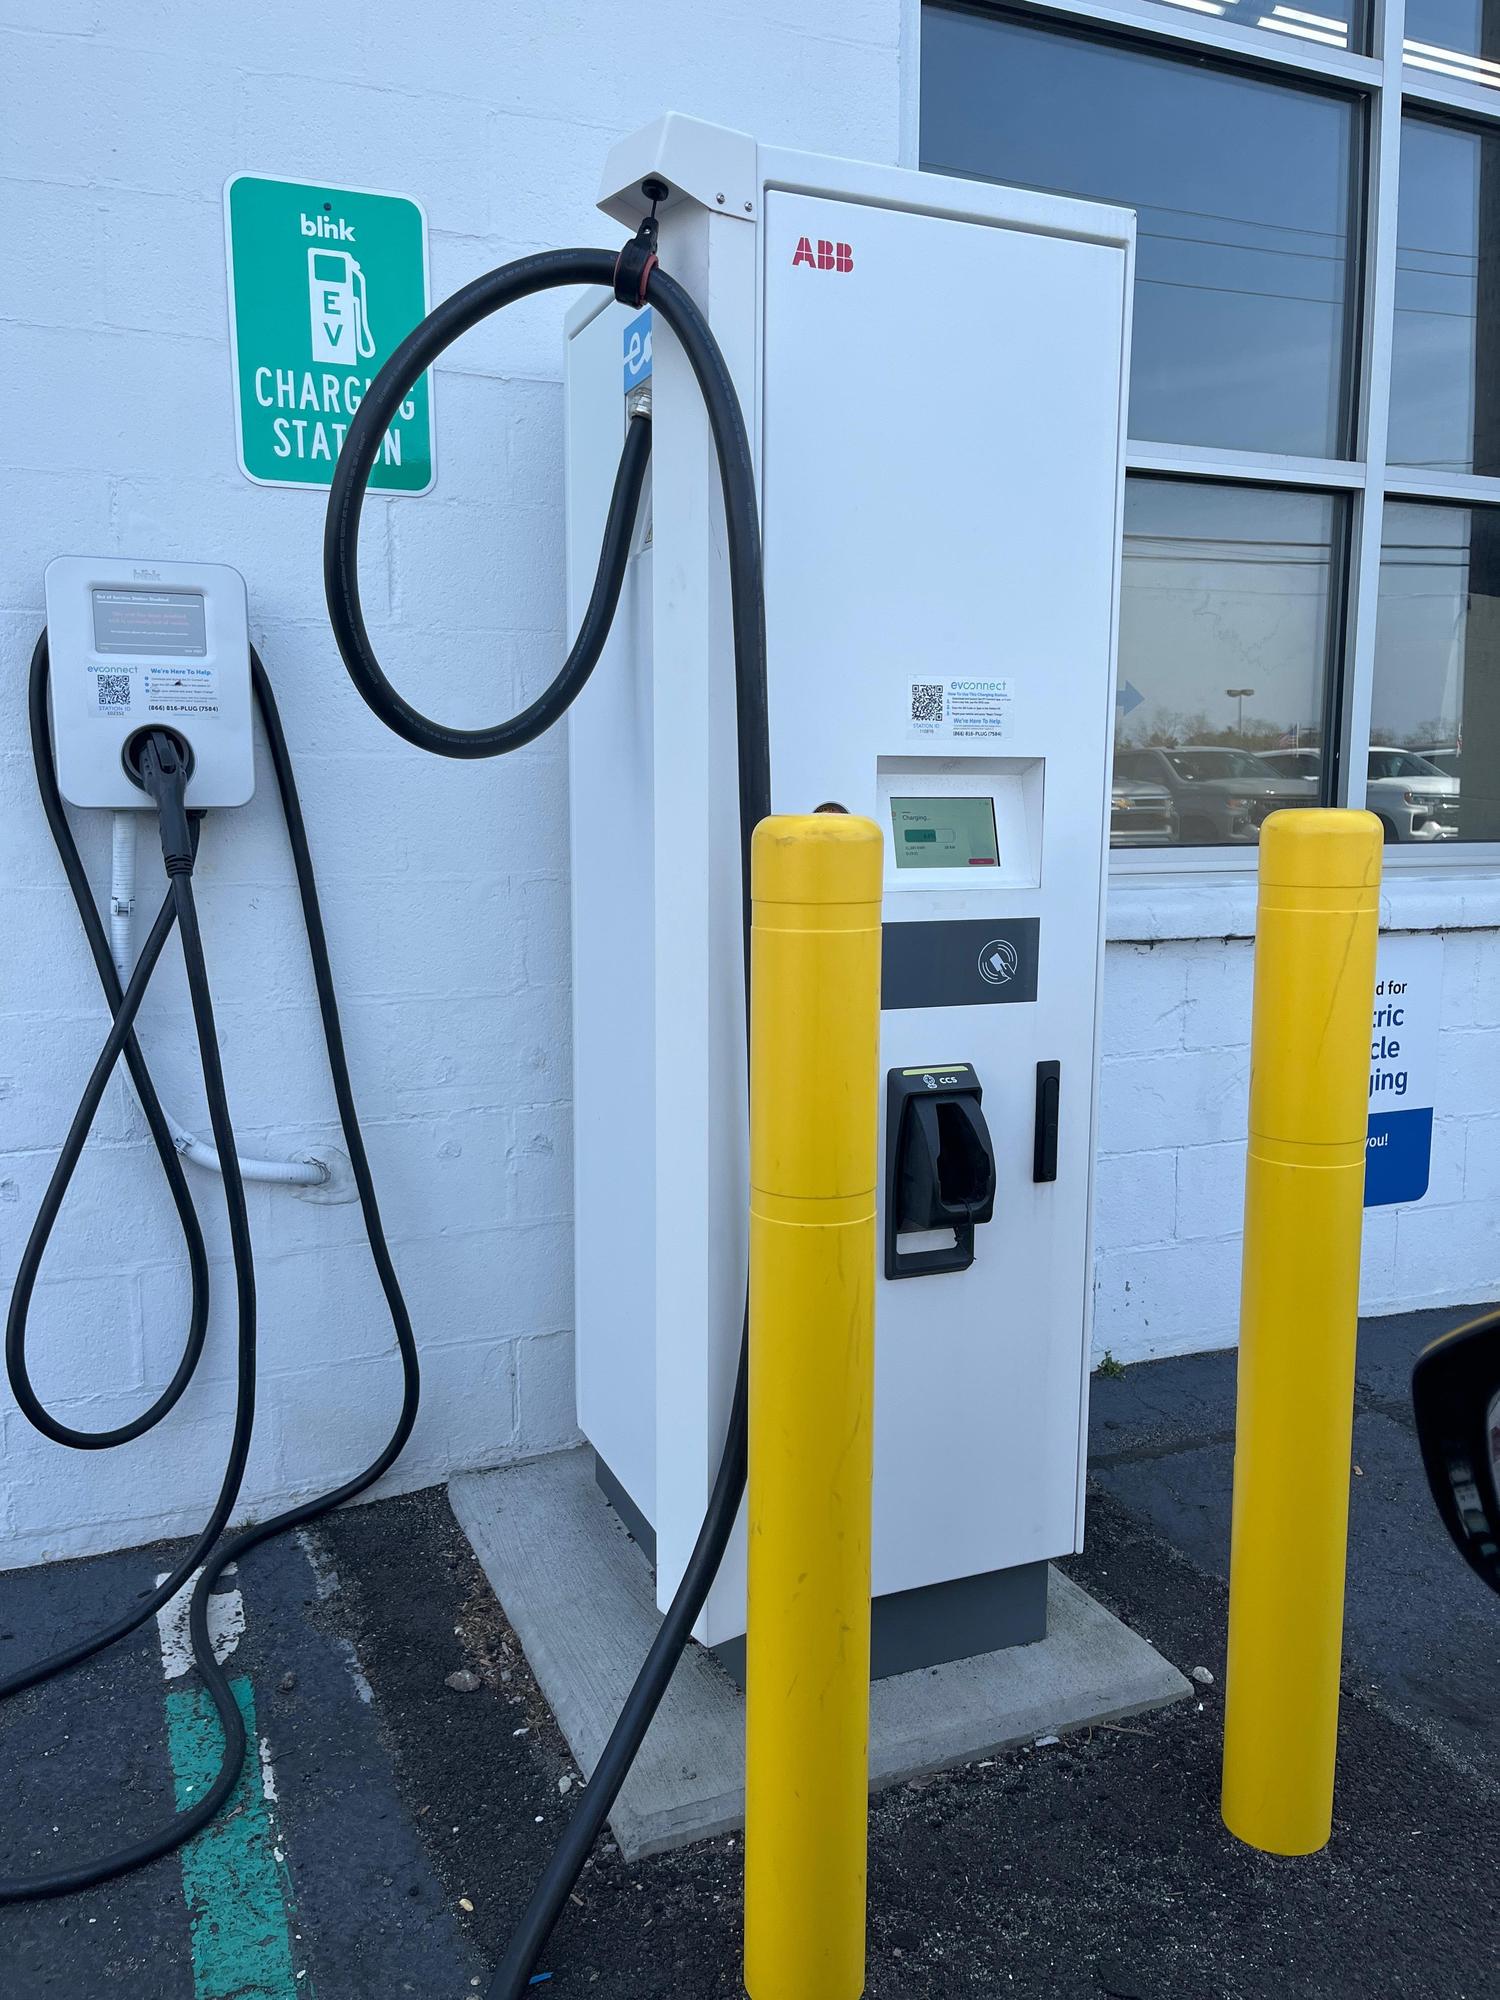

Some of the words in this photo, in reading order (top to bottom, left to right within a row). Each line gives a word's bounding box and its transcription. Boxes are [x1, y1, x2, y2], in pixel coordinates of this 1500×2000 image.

[300, 213, 356, 242] blink
[792, 237, 854, 273] ABB
[255, 366, 416, 420] CHARGG
[273, 417, 402, 466] STATN
[87, 665, 138, 674] evconnect
[951, 680, 1007, 691] evconnect
[1388, 980, 1408, 995] for
[939, 1076, 958, 1084] CCS
